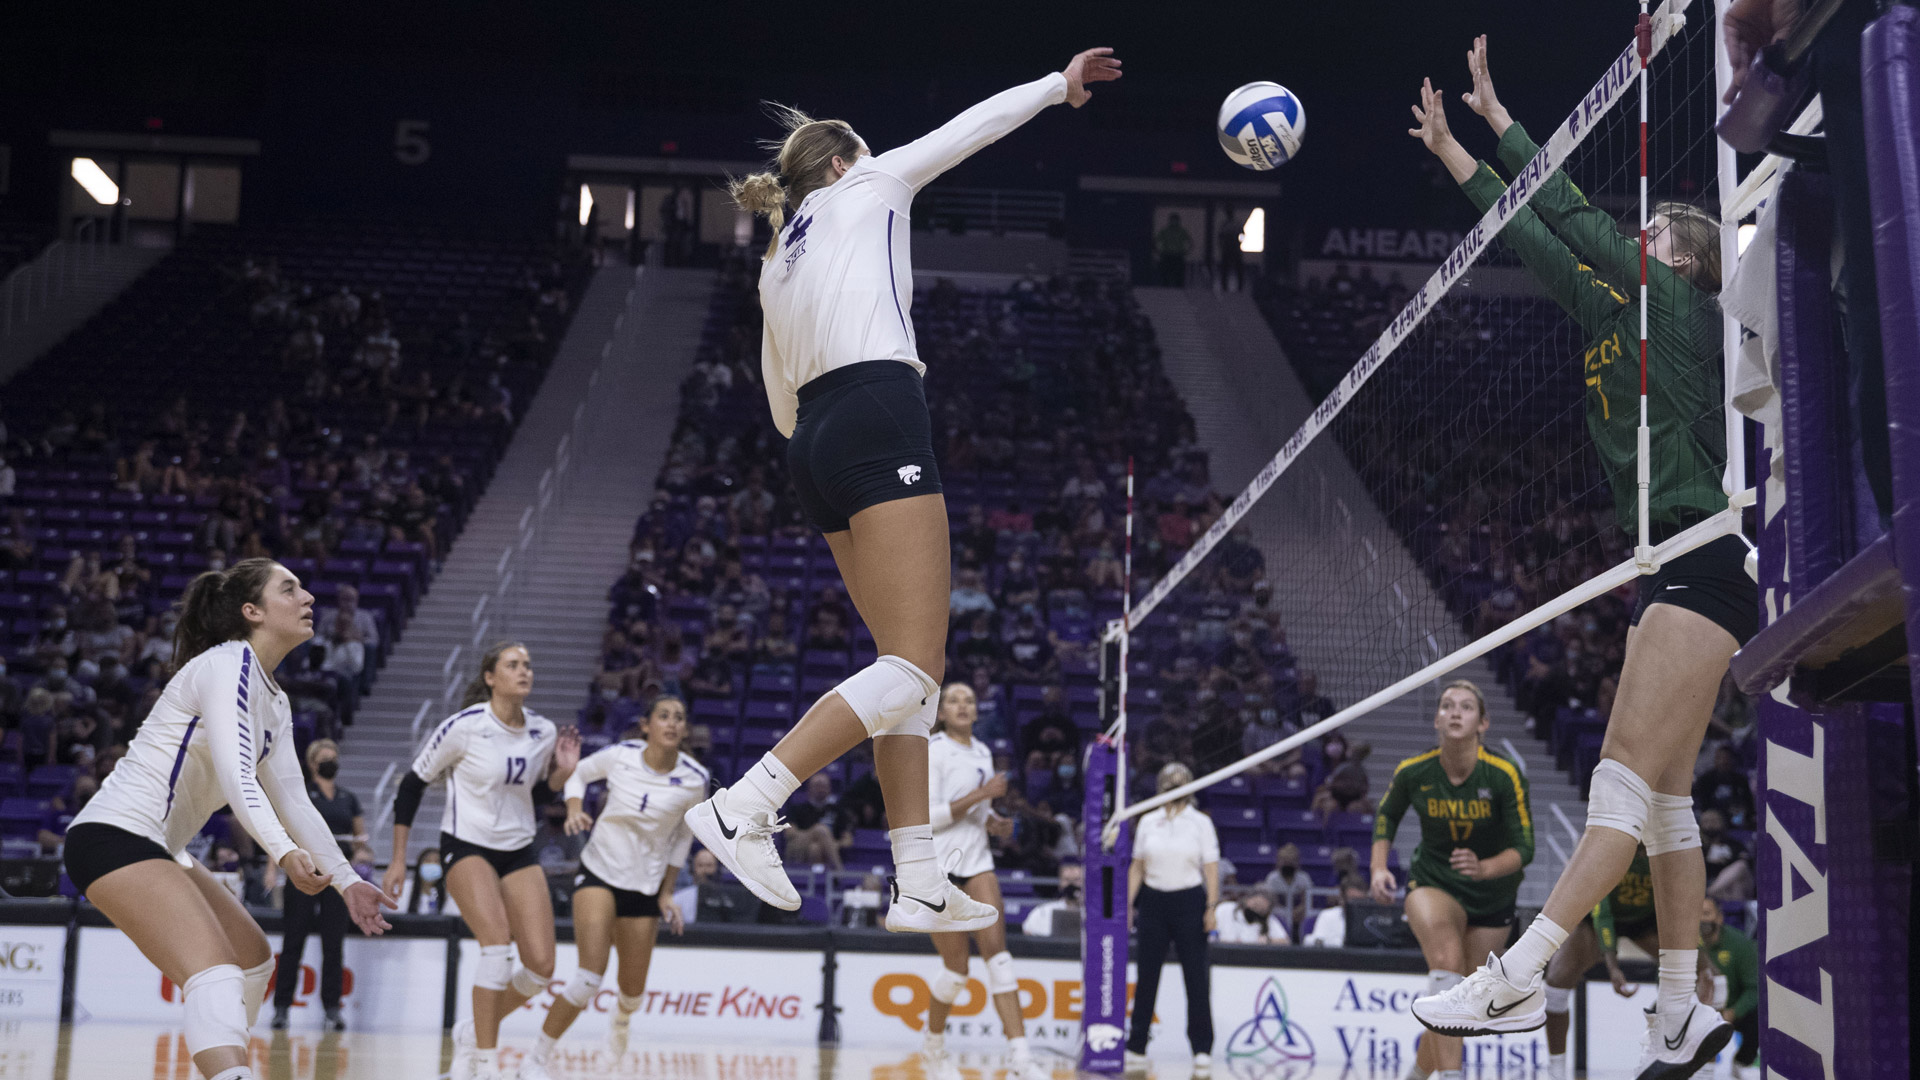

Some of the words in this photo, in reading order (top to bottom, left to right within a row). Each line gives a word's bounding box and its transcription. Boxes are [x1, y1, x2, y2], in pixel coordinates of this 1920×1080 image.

[1583, 43, 1634, 127] K-STATE
[395, 120, 432, 165] 5
[1509, 142, 1550, 211] K-STATE
[1449, 220, 1484, 278] K-STATE
[505, 757, 527, 785] 12
[640, 793, 648, 812] 1
[1427, 797, 1492, 820] BAYLOR
[1449, 820, 1474, 842] 17
[1334, 1026, 1401, 1061] Via
